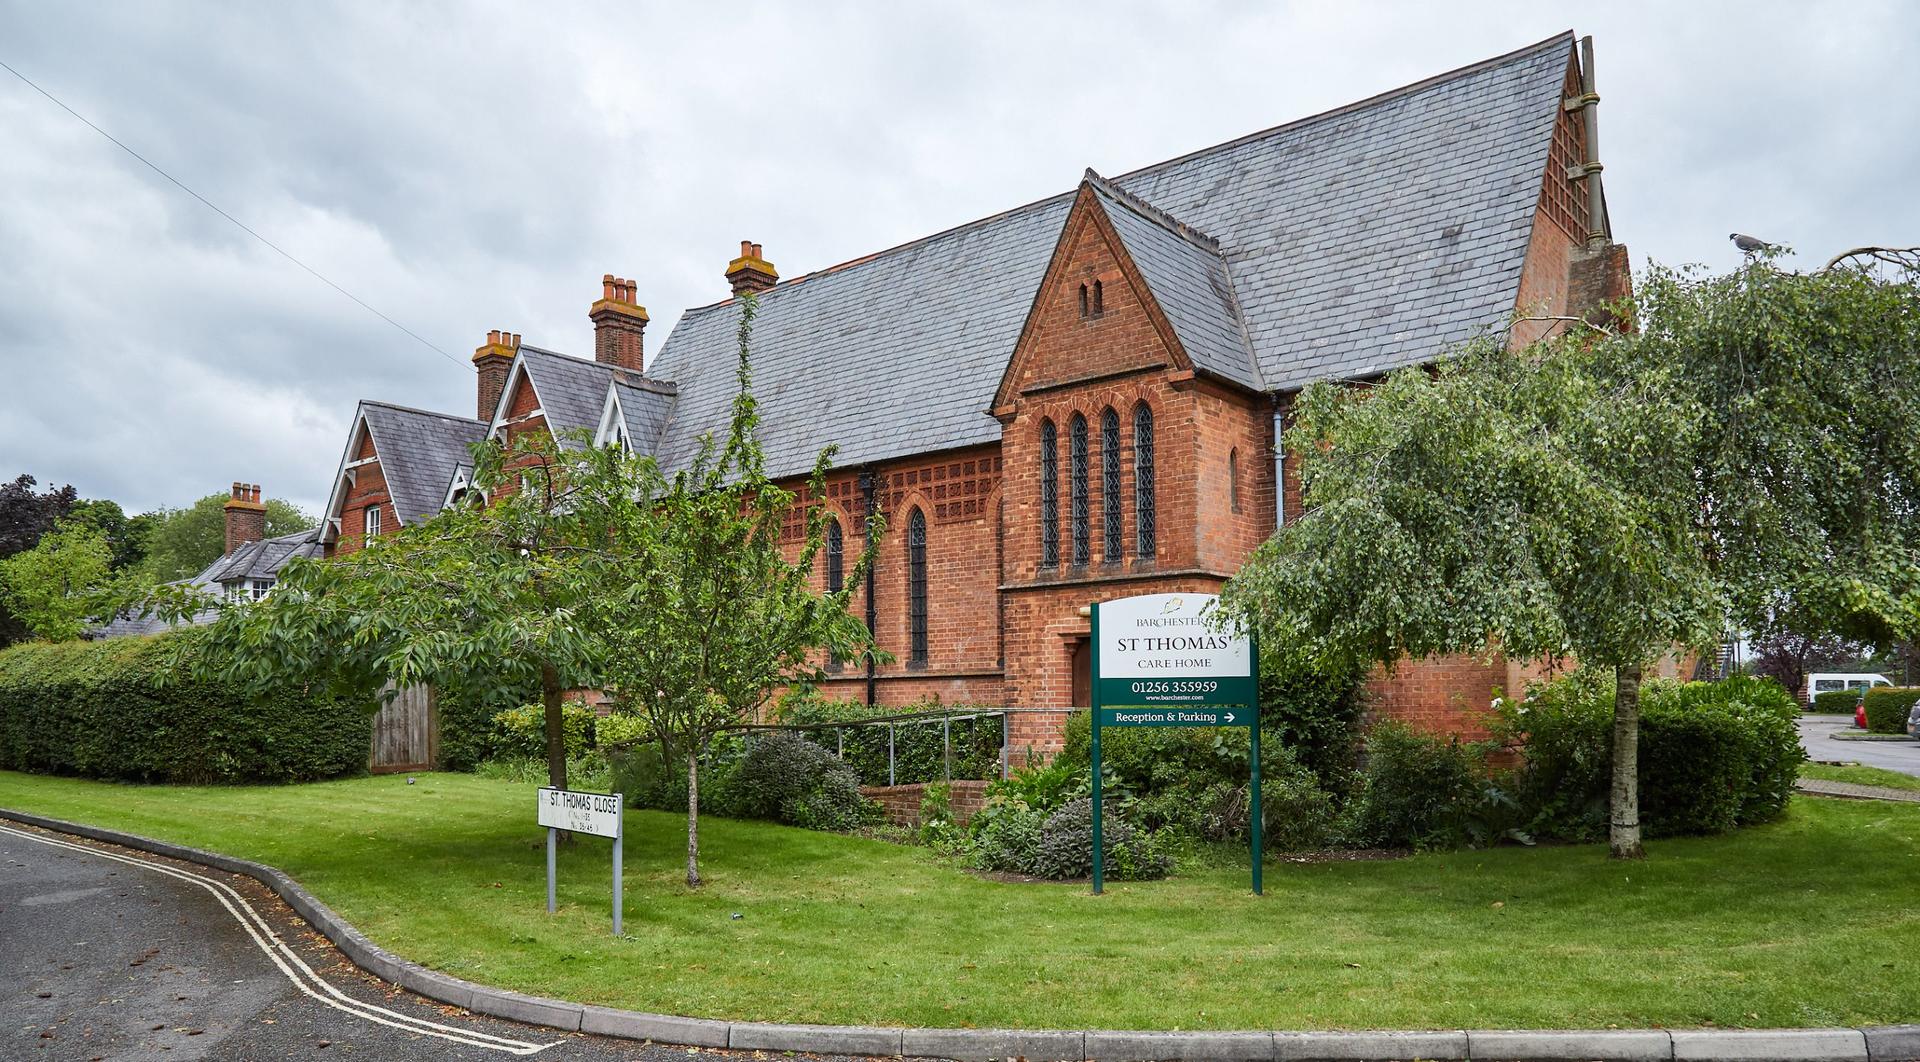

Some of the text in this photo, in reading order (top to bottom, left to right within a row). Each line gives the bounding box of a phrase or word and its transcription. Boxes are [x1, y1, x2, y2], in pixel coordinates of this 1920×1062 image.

[1136, 617, 1206, 628] BARCHESTER
[1118, 636, 1232, 651] ST THOMAS'
[1137, 658, 1212, 669] CARE HOME
[1132, 681, 1217, 693] 01256 355959
[1116, 712, 1217, 724] Reception & Parking
[562, 793, 591, 811] THOMAS
[594, 797, 617, 814] CLOSE
